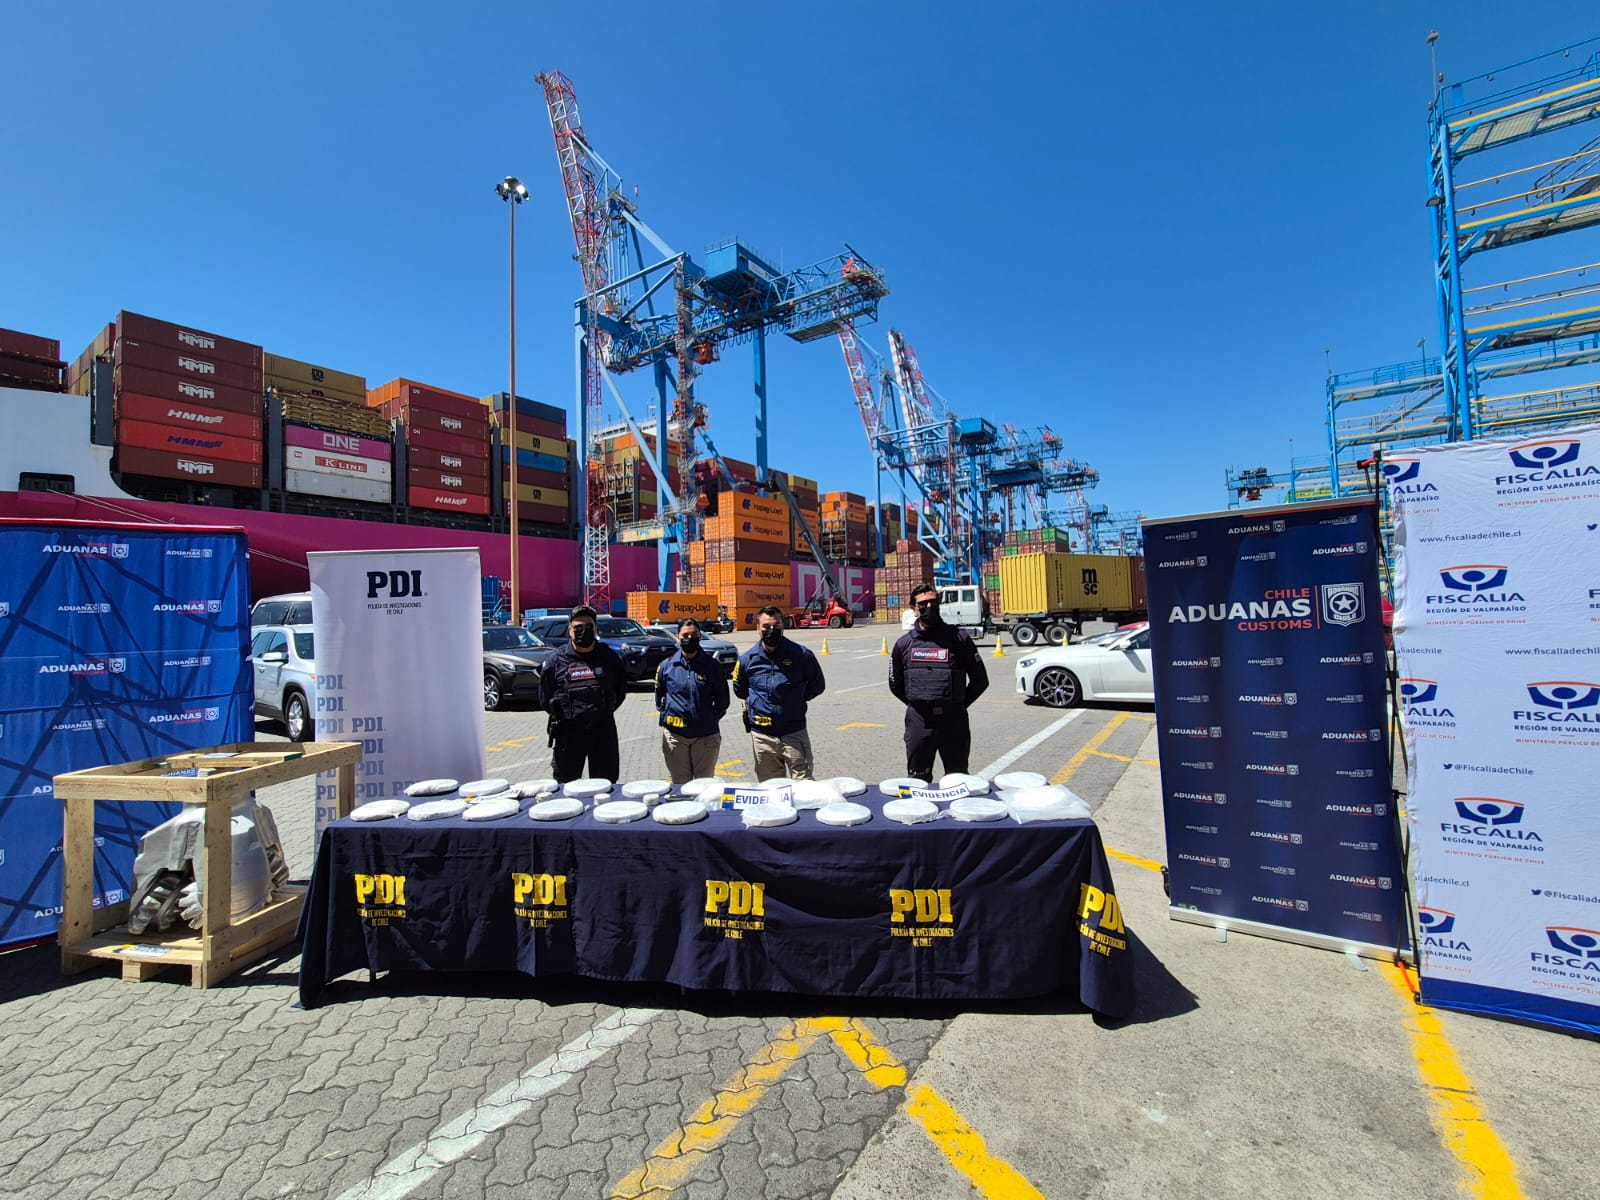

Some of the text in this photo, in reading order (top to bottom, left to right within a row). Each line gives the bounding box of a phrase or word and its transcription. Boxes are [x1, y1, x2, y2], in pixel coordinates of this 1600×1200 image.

[178, 330, 215, 349] HMM
[178, 356, 215, 374] HMM
[178, 382, 215, 399] HMM
[168, 409, 217, 424] HMM
[323, 432, 360, 451] ONE
[177, 459, 214, 475] HMM
[325, 458, 364, 472] K LINE
[1496, 466, 1600, 485] FISCALIA
[1497, 487, 1530, 495] REGIÓN
[754, 504, 783, 514] Hapag-Lloyd
[754, 524, 784, 536] Hapag-Lloyd
[1228, 524, 1270, 534] ADUANAS
[1419, 530, 1521, 543] www.fiscaliadechile.cl
[42, 544, 108, 554] ADUANAS
[1312, 546, 1354, 556] ADUANAS
[1159, 560, 1195, 568] ADUANAS
[755, 570, 784, 580] Hapag-Lloyd
[367, 570, 422, 598] PDI
[756, 591, 785, 602] Hapag-Lloyd
[1264, 588, 1310, 600] CHILE
[1426, 593, 1526, 604] FISCALIA
[153, 604, 204, 612] ADUANAS
[674, 602, 710, 614] Hapag-Lloyd
[1168, 598, 1312, 624] ADUANAS
[1426, 606, 1457, 614] REGIÓN
[1238, 619, 1312, 632] CUSTOMS
[1320, 656, 1361, 664] ADUANAS
[40, 662, 105, 674] ADUANAS
[317, 674, 344, 690] PDI
[317, 696, 344, 712] PDI
[149, 712, 202, 723] ADUANAS
[1404, 707, 1455, 718] ALIA
[318, 717, 384, 734] PDI PDI
[1169, 728, 1208, 736] ADUANAS
[1322, 732, 1367, 740] ADUANAS
[1246, 764, 1285, 772] ADUANAS
[1454, 764, 1534, 775] @FiscaliadeChile
[912, 787, 967, 798] EVIDENCIA
[1173, 792, 1212, 801] ADUANAS
[1326, 804, 1372, 814] ADUANAS
[1250, 831, 1289, 841] ADUANAS
[1440, 823, 1542, 842] FISCALIA
[1442, 836, 1474, 844] REGIÓN
[1490, 842, 1544, 852] VALPARAÍSO
[1178, 854, 1216, 864] ADUANAS
[1329, 874, 1376, 886] ADUANAS
[354, 874, 406, 905] PDI
[512, 872, 567, 905] PDI
[705, 880, 765, 916] PDI
[1251, 896, 1293, 907] ADUANAS
[890, 889, 953, 922] PDI
[916, 928, 954, 936] INVESTIGACIONES
[1420, 936, 1471, 952] ALIA
[1532, 966, 1566, 976] REGIÓN
